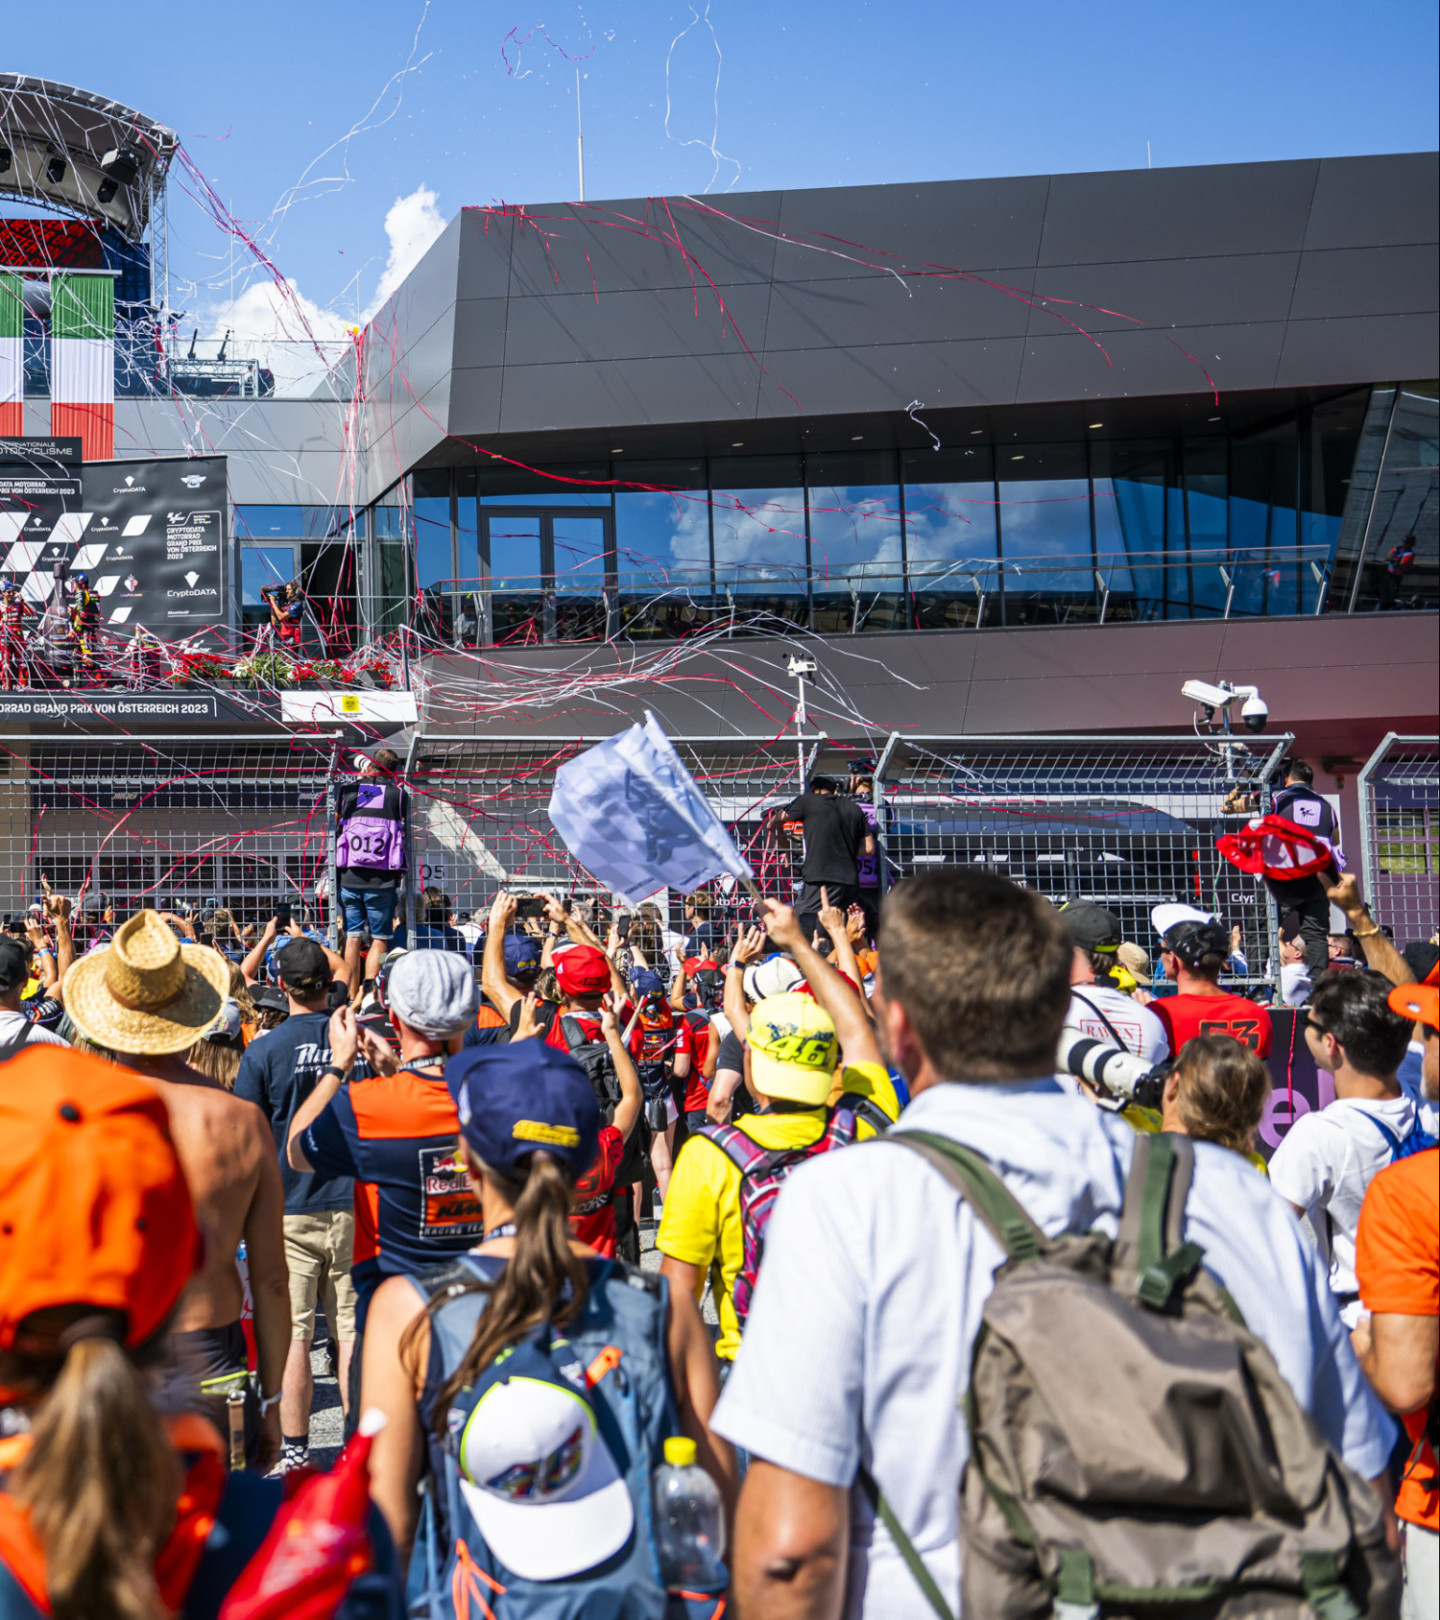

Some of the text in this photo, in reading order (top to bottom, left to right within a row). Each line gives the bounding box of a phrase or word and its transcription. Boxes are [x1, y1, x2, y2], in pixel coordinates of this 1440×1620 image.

[113, 486, 146, 494] CryptoDATA
[166, 526, 206, 534] CRYPTODATA
[167, 588, 218, 598] CryptoDATA
[34, 703, 68, 713] GRAND
[70, 703, 94, 713] PRIX
[95, 704, 116, 713] VON
[118, 702, 178, 714] ÖSTERREICH
[181, 704, 208, 714] 2023
[350, 835, 385, 854] 012
[763, 1034, 832, 1066] 46
[426, 1174, 460, 1194] Red
[435, 1200, 483, 1217] KTM
[424, 1224, 484, 1235] RACING TEA
